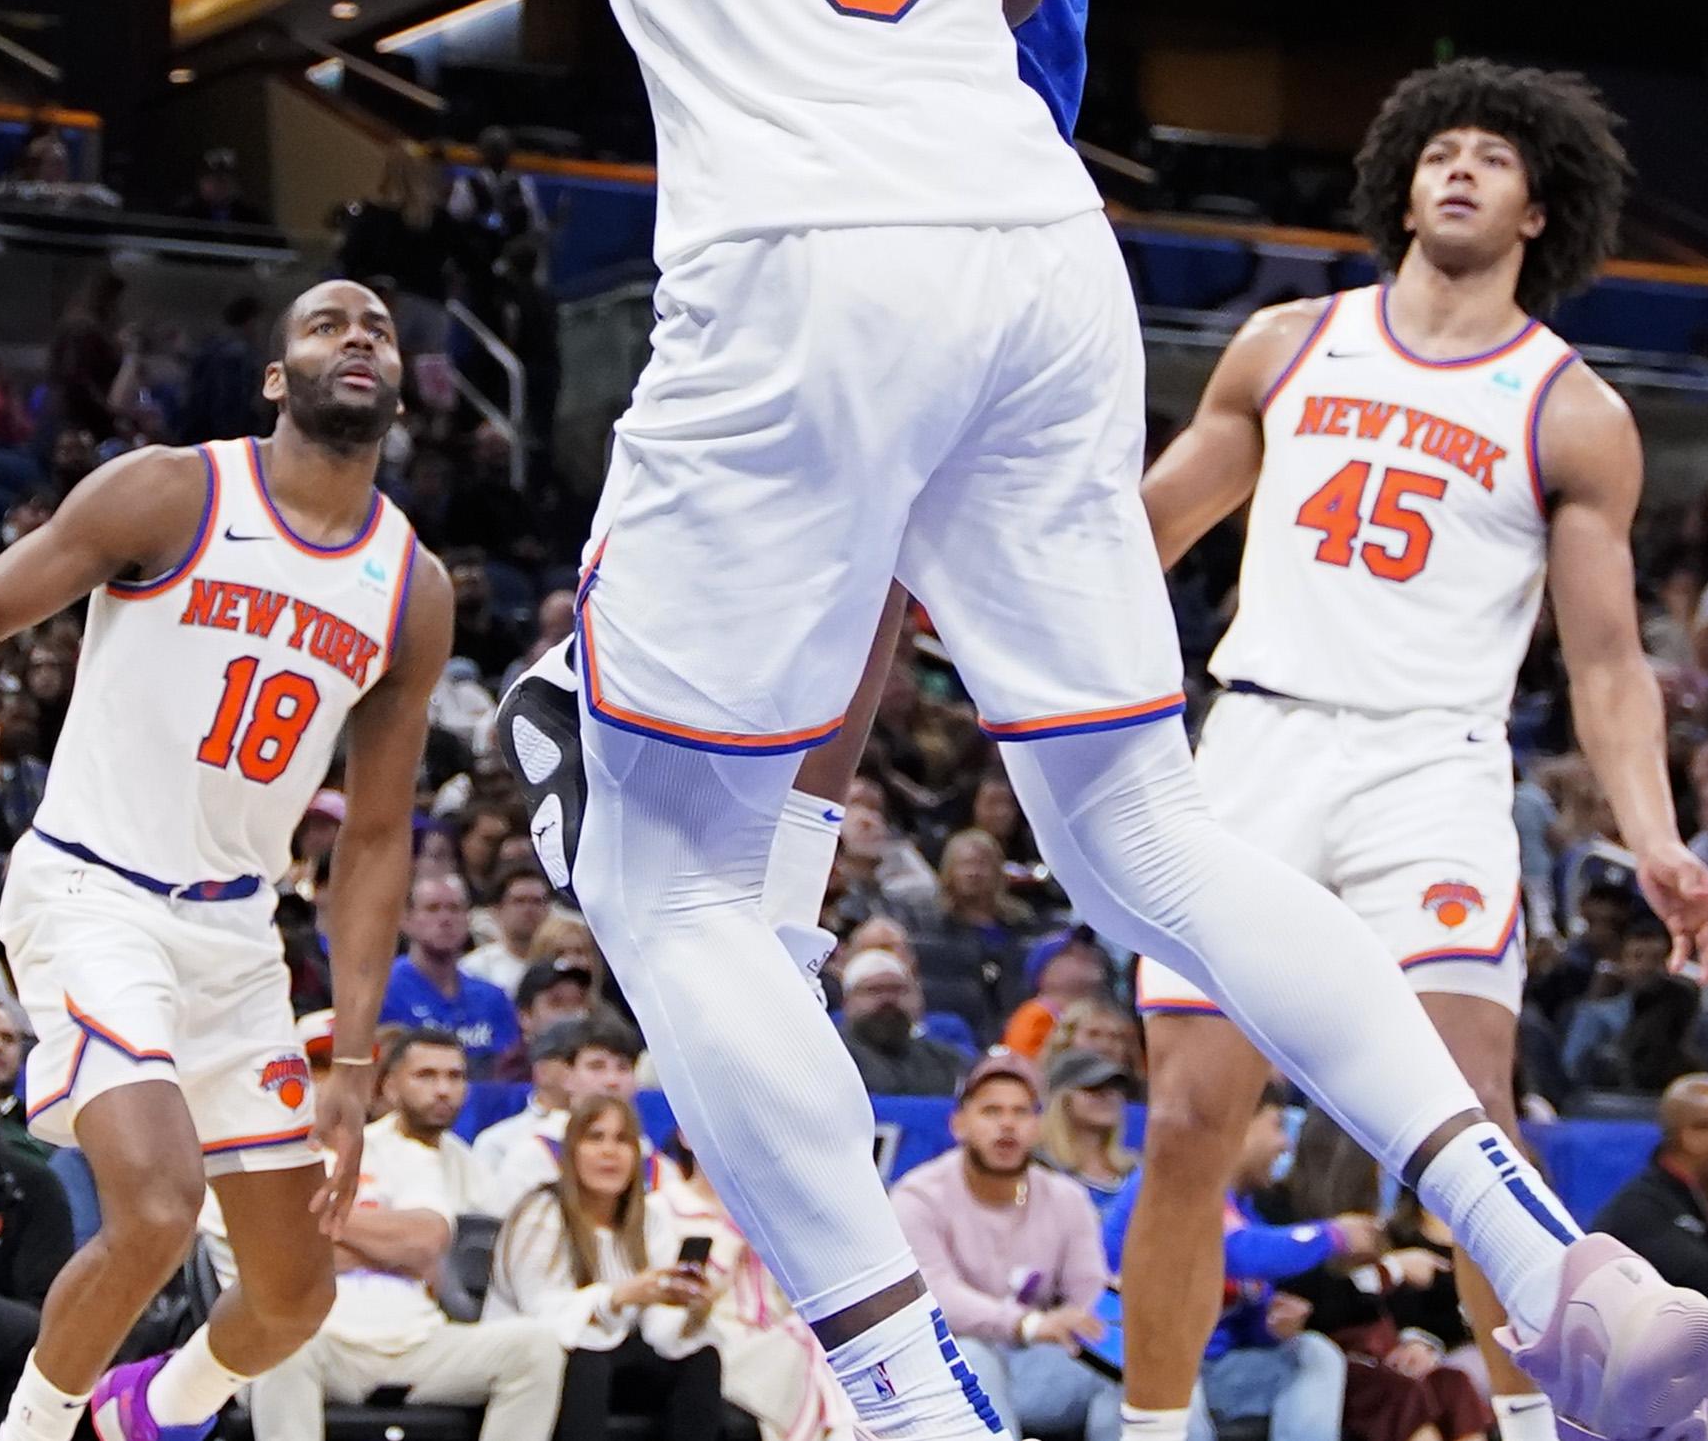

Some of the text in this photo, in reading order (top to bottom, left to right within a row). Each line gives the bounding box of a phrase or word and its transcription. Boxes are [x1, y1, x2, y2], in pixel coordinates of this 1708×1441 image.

[1294, 396, 1508, 492] NEW YORK
[1294, 459, 1448, 583] 45
[179, 578, 383, 688] NEW YORK
[197, 655, 320, 785] 18
